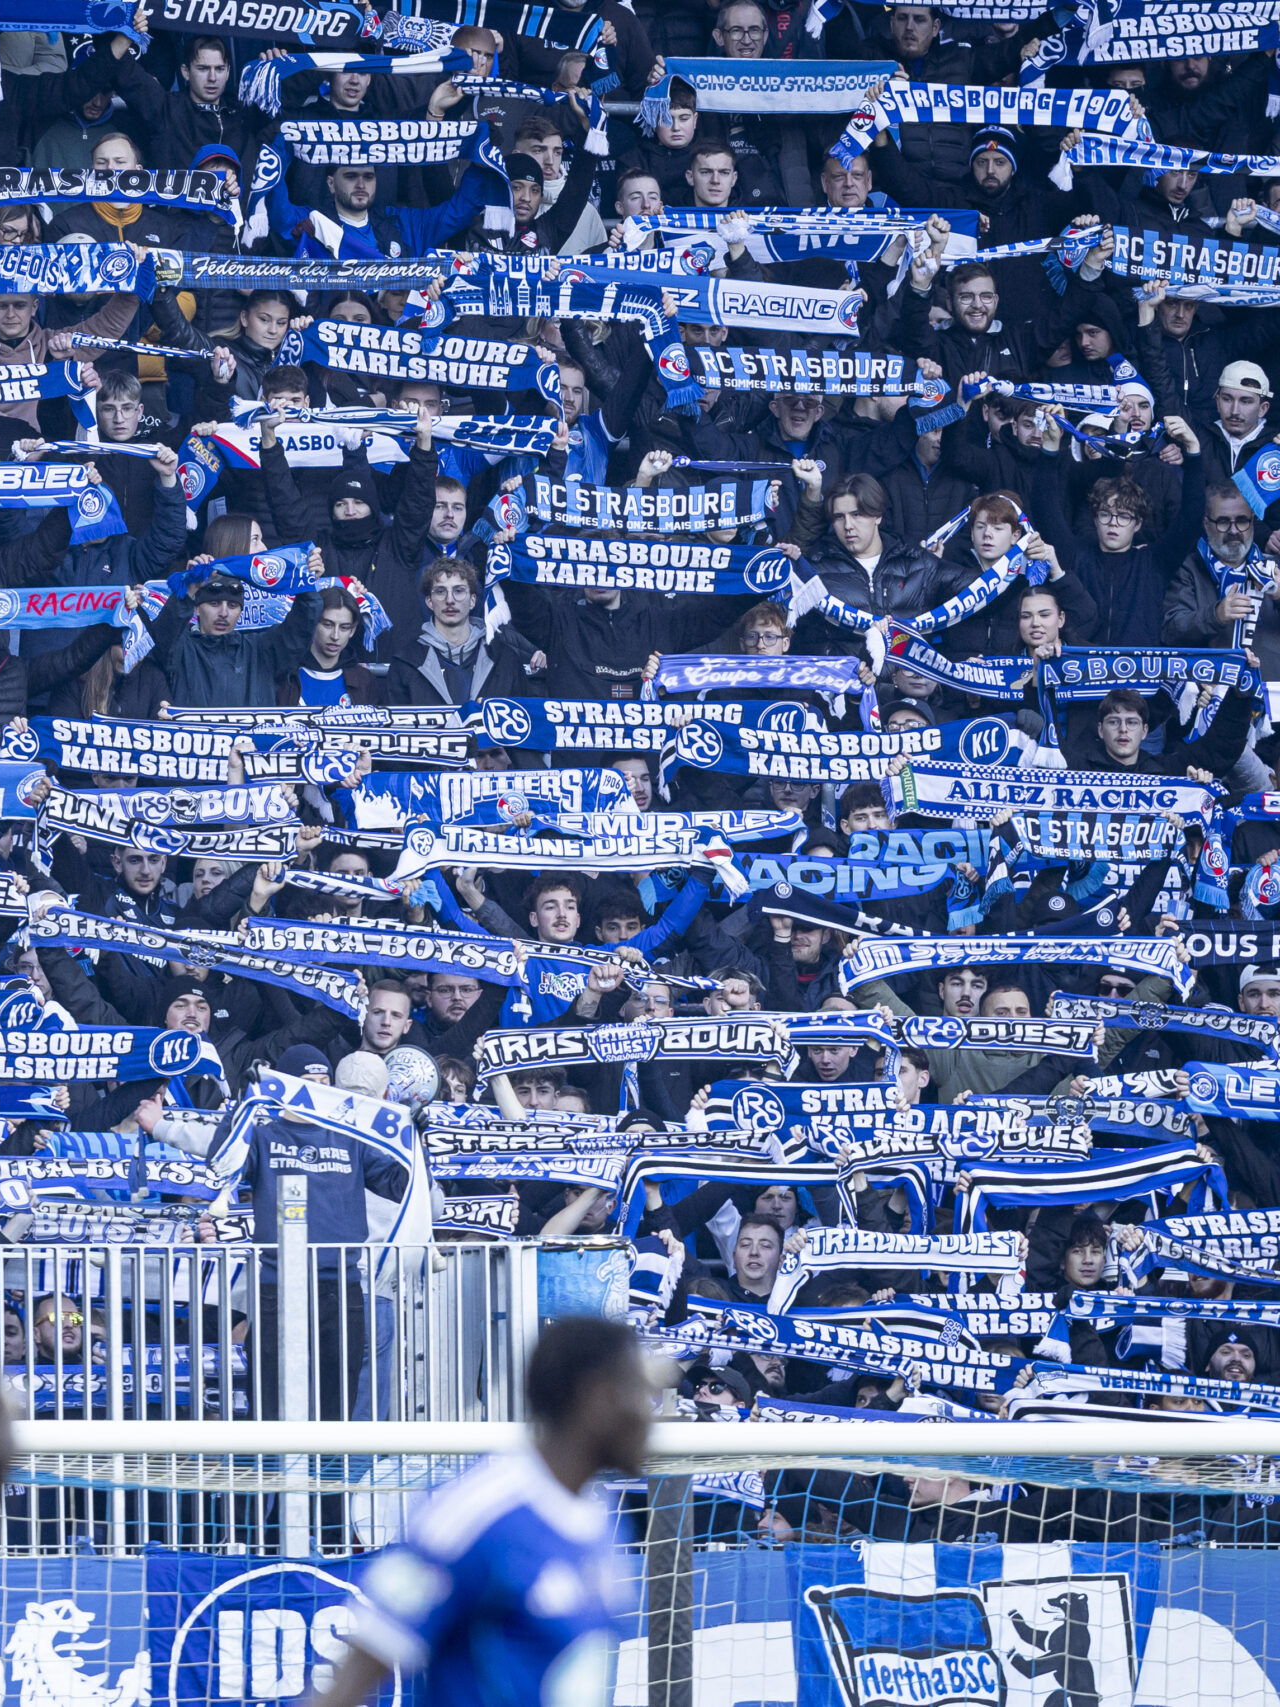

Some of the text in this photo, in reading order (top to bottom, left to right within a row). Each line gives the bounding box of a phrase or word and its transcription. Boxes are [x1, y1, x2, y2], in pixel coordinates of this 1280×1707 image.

[164, 0, 348, 37] STRASBOURG
[1094, 31, 1260, 62] KARLSRUHE
[740, 75, 780, 91] CLUB
[880, 86, 1053, 112] STRASBOURG
[280, 121, 478, 144] STRASBOURG
[293, 140, 462, 165] KARLSRUHE
[1114, 234, 1144, 260] RC
[191, 258, 441, 286] Fédération des Supporters
[1130, 264, 1172, 281] SOMMES
[1174, 271, 1194, 284] PAS
[720, 291, 839, 321] RACING
[327, 345, 510, 390] KARLSRUHE
[703, 351, 902, 380] RC STRASBOURG
[723, 380, 766, 392] SOMMES
[770, 382, 793, 393] PAS
[860, 384, 881, 394] DES
[539, 480, 737, 520] RC STRASBOURG
[554, 509, 595, 526] SOMMES
[599, 515, 623, 528] PAS
[694, 518, 715, 529] DES
[718, 511, 762, 527] MILLIERS
[526, 534, 731, 569] STRASBOURG
[535, 561, 716, 593] KARLSRUHE
[26, 593, 123, 618] RACING
[684, 665, 761, 690] Coupe
[907, 640, 1006, 688] KARLSRUHE
[739, 727, 942, 759] STRASBOURG
[902, 766, 916, 808] TOURTEL
[961, 771, 1161, 788] RACING CLUB STRASBOURG
[944, 780, 1179, 812] ALLEZ RACING
[1013, 817, 1040, 842] RC
[1033, 845, 1092, 860] SOMMES PAS
[970, 1019, 1095, 1055] OUEST
[268, 1157, 352, 1175] STRASBOURG
